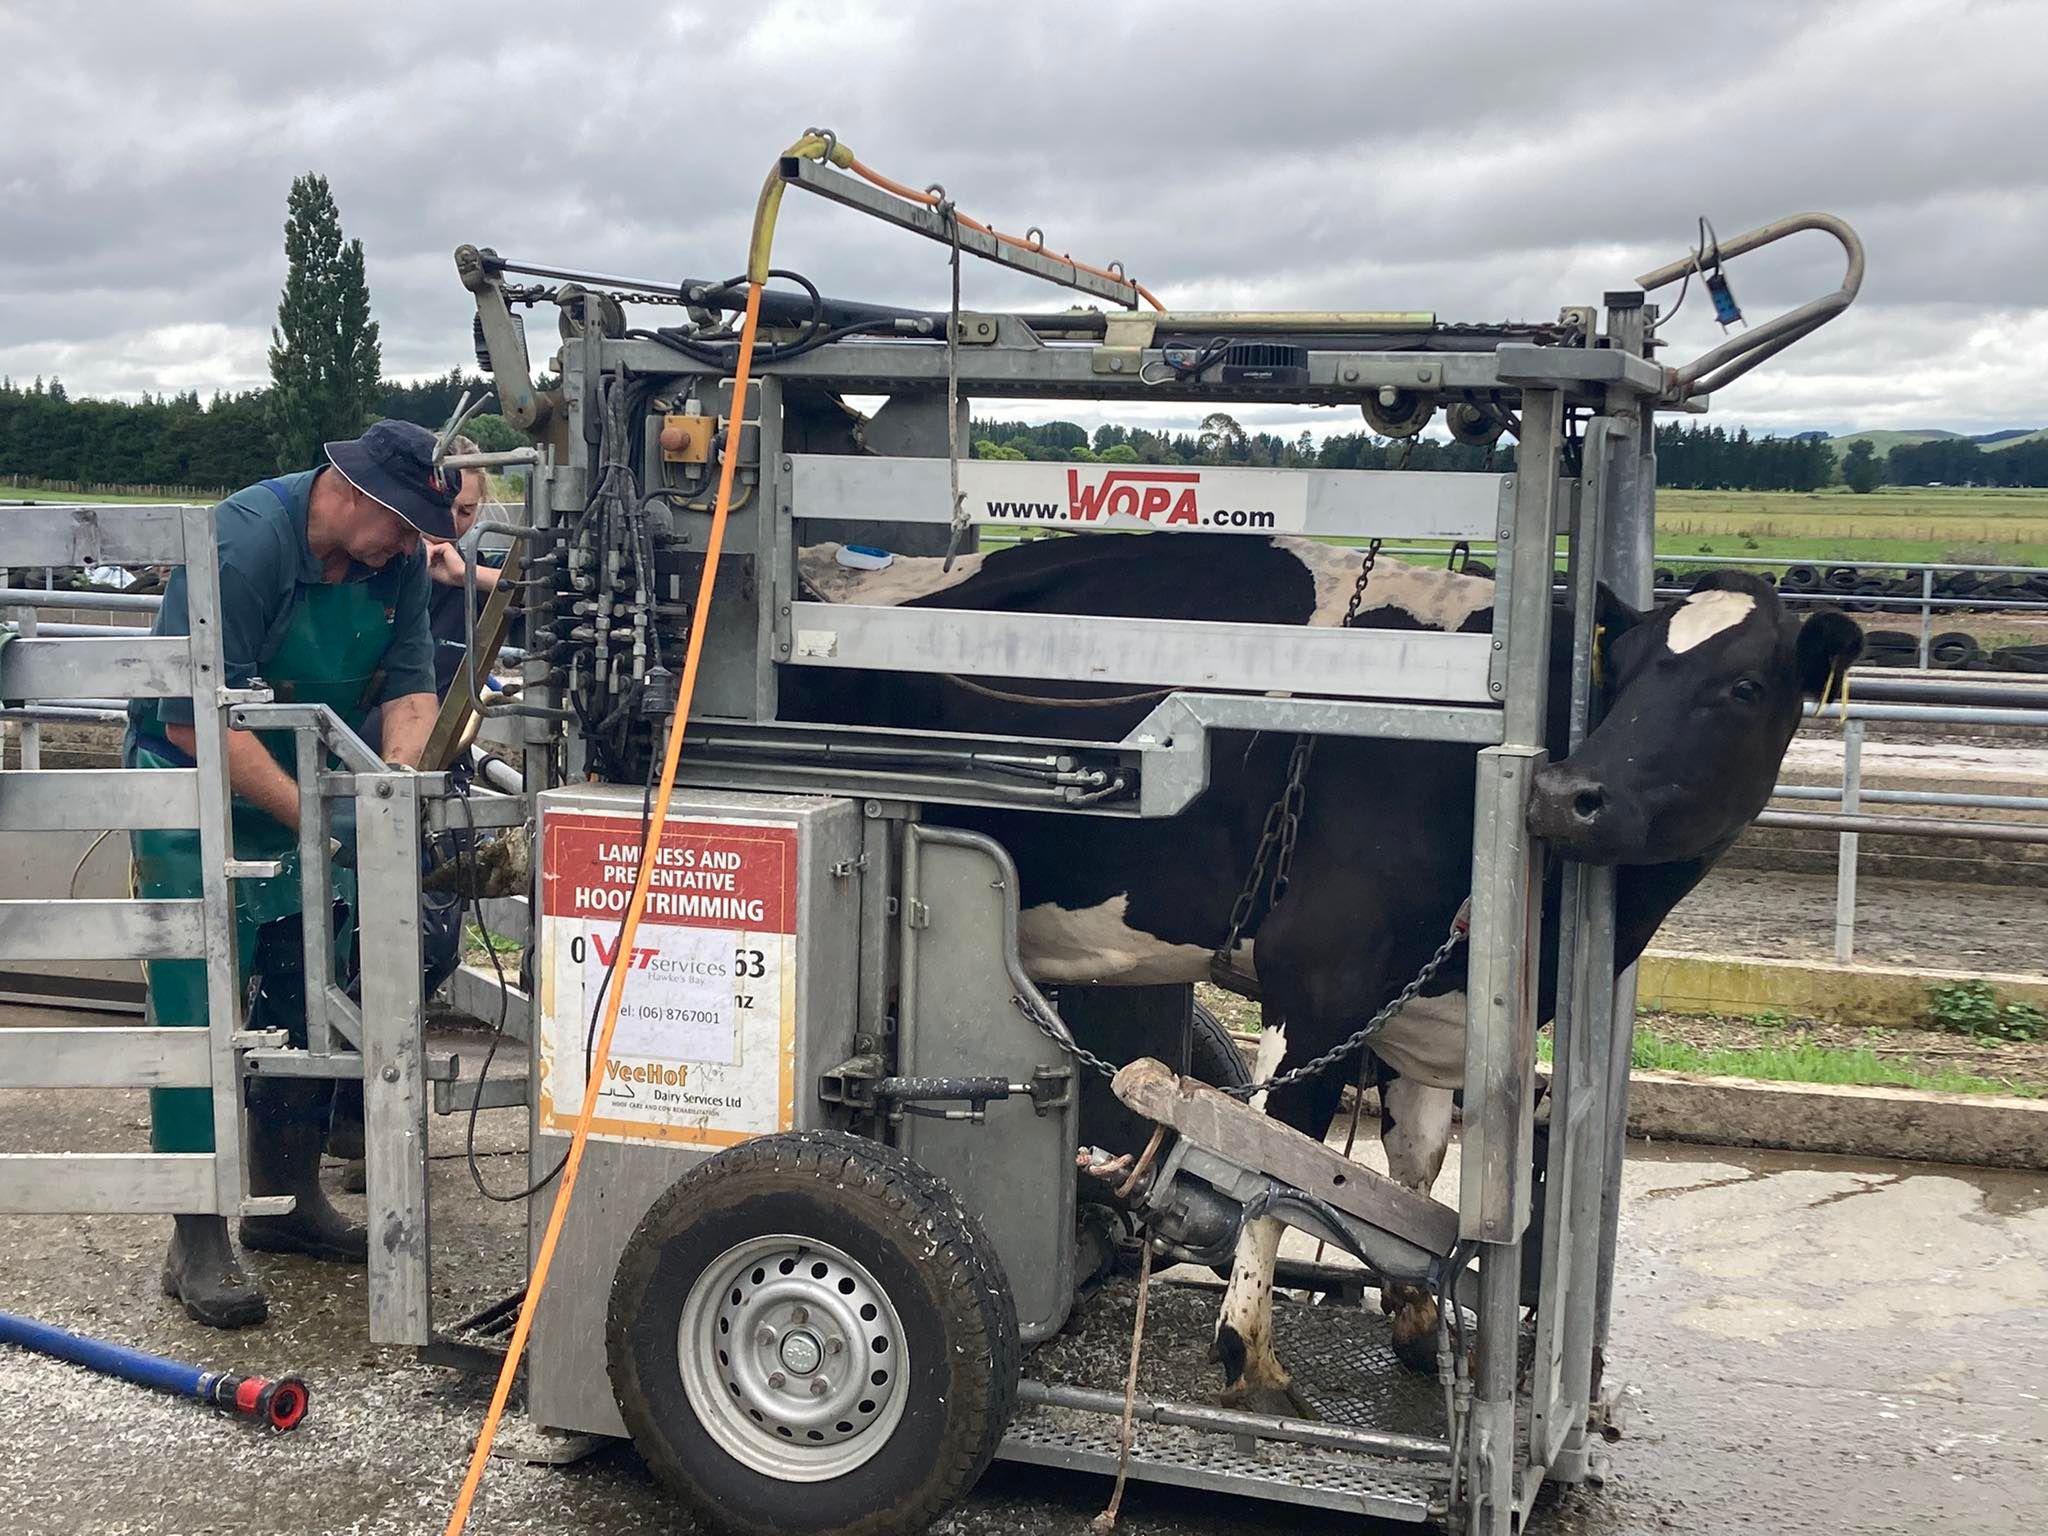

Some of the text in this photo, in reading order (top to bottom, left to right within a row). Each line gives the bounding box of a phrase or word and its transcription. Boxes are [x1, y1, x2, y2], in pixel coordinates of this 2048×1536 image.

[699, 851, 742, 870] AND
[604, 866, 735, 891] PREENTATIVE
[645, 893, 765, 921] TRIMMING
[689, 976, 705, 986] Bay
[620, 1006, 720, 1024] el: (06) 8767001
[606, 1060, 689, 1087] VeeHof
[654, 1089, 742, 1108] Dairy Services Ltd
